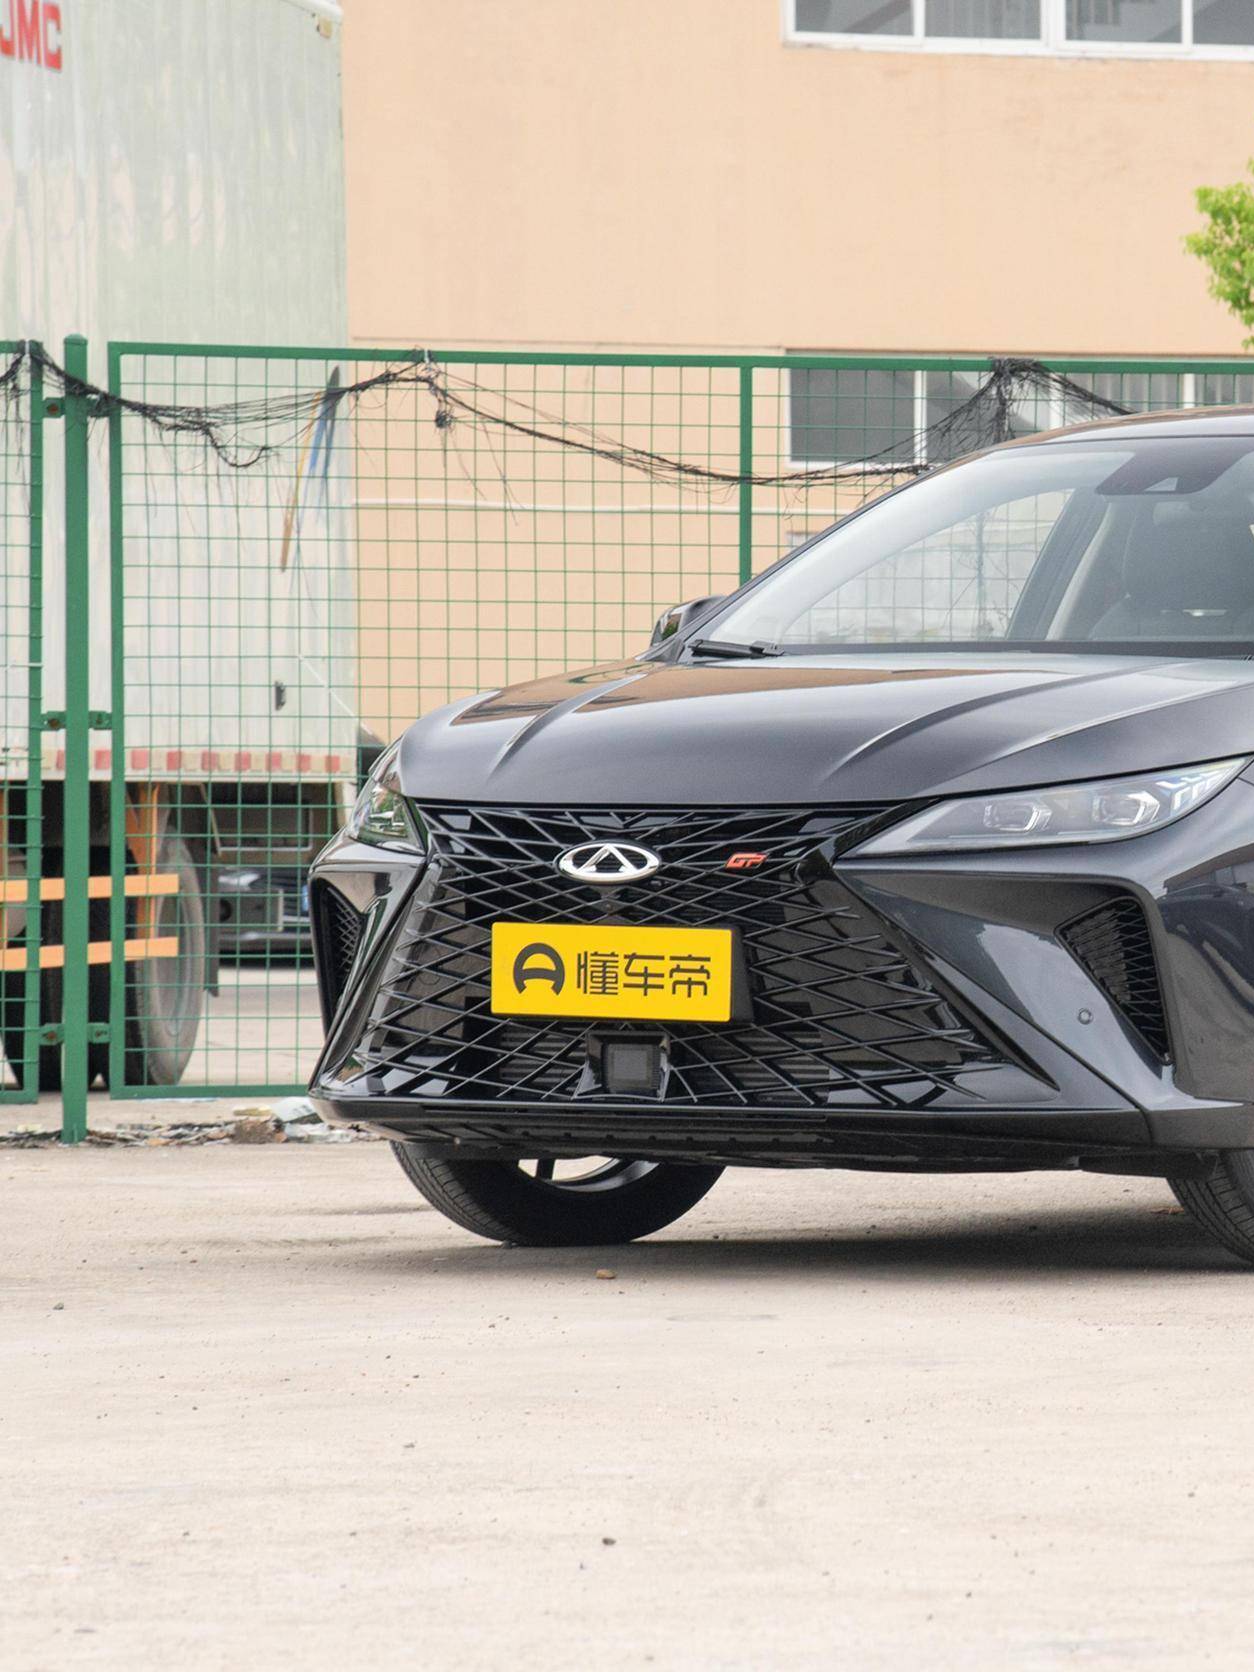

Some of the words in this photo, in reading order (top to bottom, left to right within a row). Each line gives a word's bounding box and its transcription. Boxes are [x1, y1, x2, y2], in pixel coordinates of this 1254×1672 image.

[0, 0, 62, 70] JMC
[577, 951, 711, 998] 懂车帝
